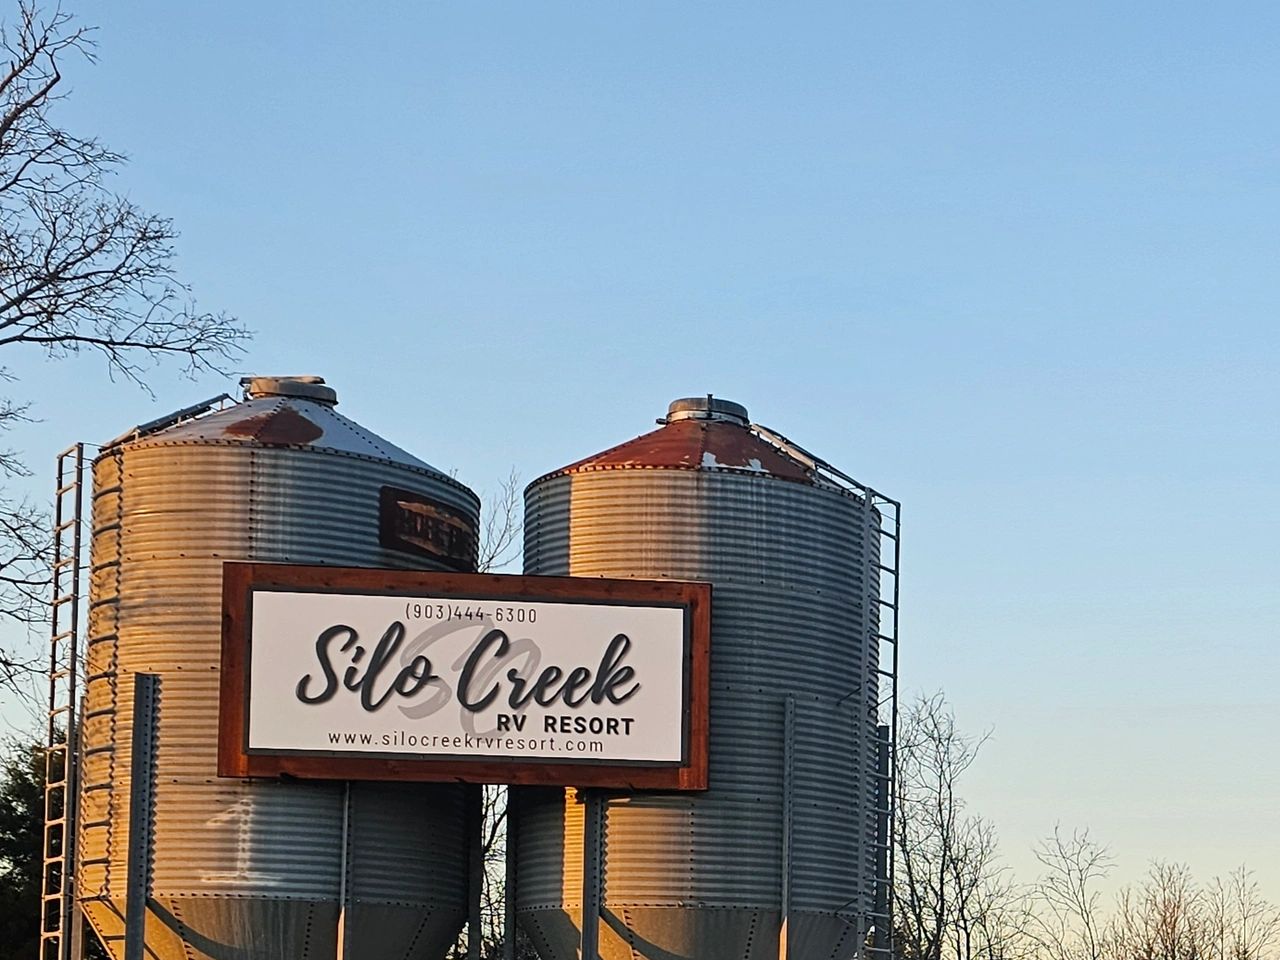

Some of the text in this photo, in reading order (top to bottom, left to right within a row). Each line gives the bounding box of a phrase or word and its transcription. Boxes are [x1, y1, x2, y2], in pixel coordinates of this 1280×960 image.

[405, 602, 538, 624] (903)444-6300
[295, 620, 642, 713] Silo Creek
[496, 713, 635, 736] RV RESORT
[327, 730, 604, 753] www.silocreekrvresort.com
